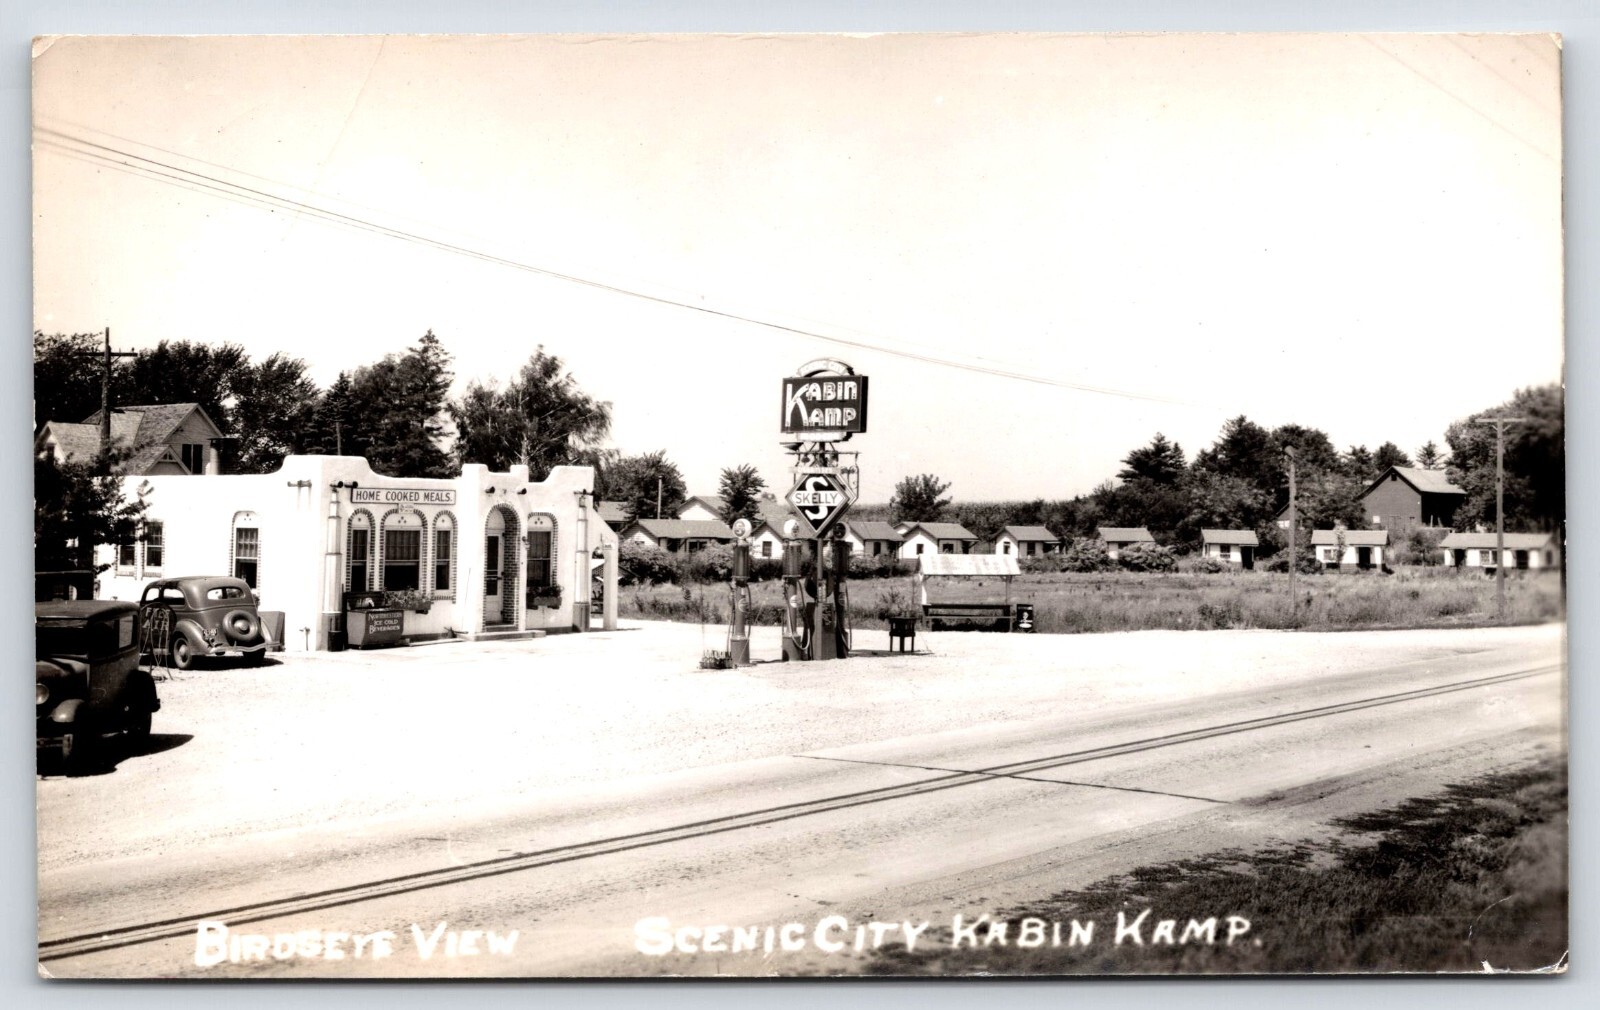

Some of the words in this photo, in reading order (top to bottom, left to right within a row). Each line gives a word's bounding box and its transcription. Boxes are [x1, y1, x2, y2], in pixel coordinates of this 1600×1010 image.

[355, 490, 381, 501] HOME
[386, 491, 420, 502] COOKED
[424, 493, 453, 503] MEALS.
[795, 493, 838, 504] SKELLY
